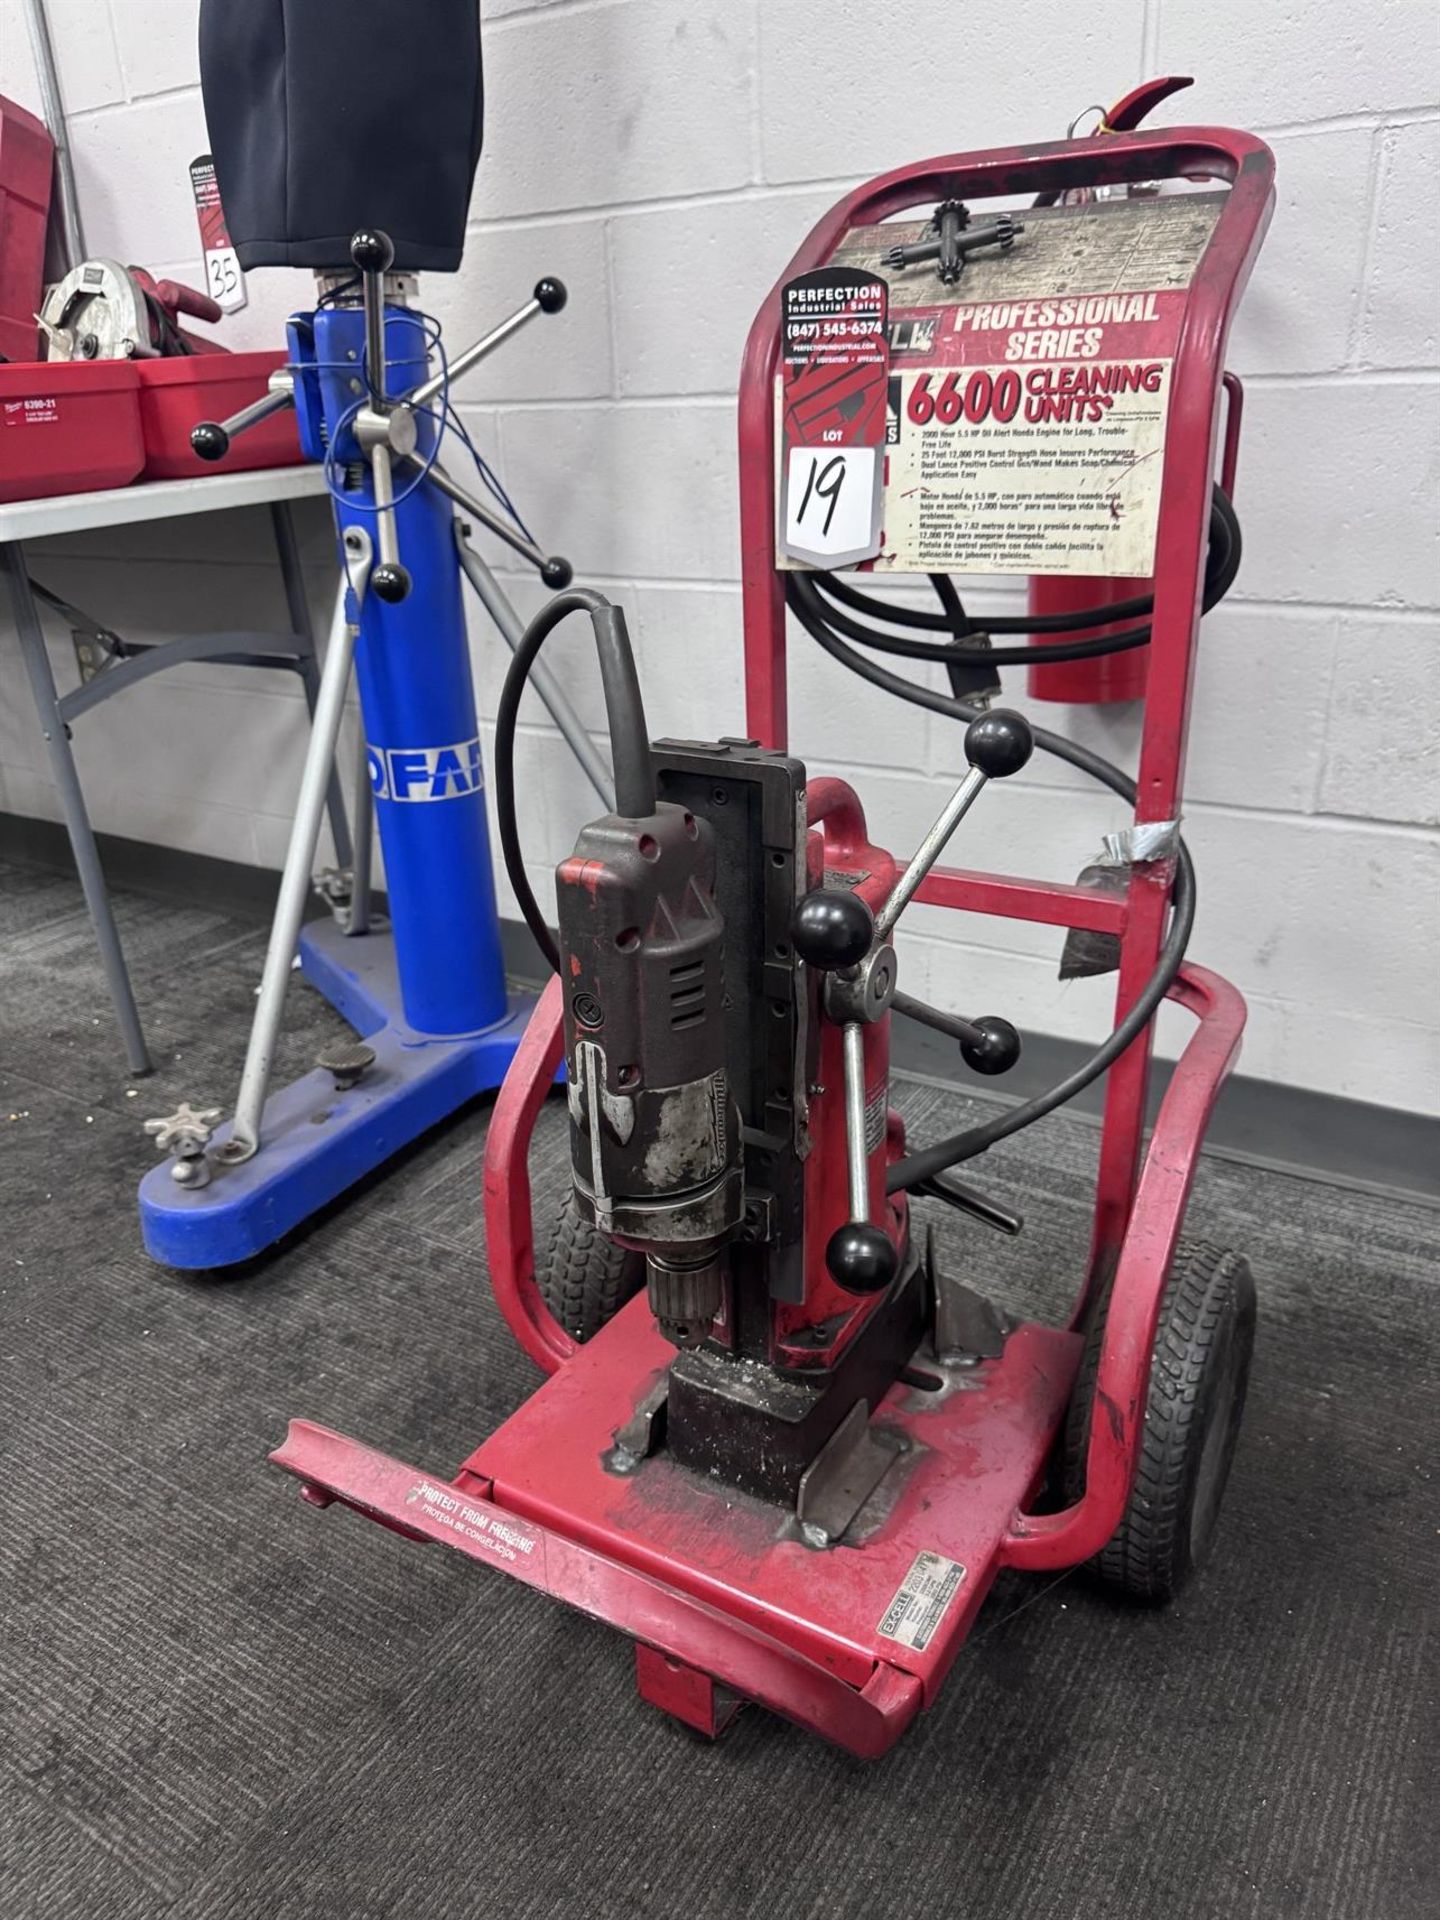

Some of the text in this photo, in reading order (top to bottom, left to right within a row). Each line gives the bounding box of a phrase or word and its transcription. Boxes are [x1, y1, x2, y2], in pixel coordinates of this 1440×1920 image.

[212, 257, 237, 298] 35
[788, 285, 881, 303] PERFECTION
[788, 301, 882, 313] Industrial Sales
[953, 294, 1160, 332] PROFESSIONAL
[787, 321, 883, 340] (847) 545-6374
[1004, 327, 1103, 361] SERIES
[1025, 363, 1164, 395] CLEANING
[907, 369, 1022, 426] 6600
[823, 430, 843, 442] LOT
[993, 429, 1011, 437] Alert
[1036, 429, 1060, 437] Engine
[1098, 427, 1128, 435] Trouble-
[949, 450, 972, 459] 12,000
[974, 450, 985, 458] PSI
[987, 449, 1006, 458] Burst
[1008, 449, 1037, 459] Strength
[1088, 448, 1135, 457] Performance
[960, 460, 987, 468] Positive
[989, 460, 1015, 468] Control
[1055, 459, 1079, 467] Makes
[921, 471, 977, 480] Application Easy
[797, 455, 846, 537] 19
[1034, 492, 1074, 500] automático
[978, 503, 997, 511] 2,000
[1058, 503, 1077, 511] larga
[1017, 523, 1036, 531] largo
[1083, 524, 1110, 532] ruptura
[920, 532, 942, 540] 12,000
[974, 533, 1004, 541] asegurar
[919, 541, 942, 549] Pistola
[979, 542, 1006, 550] positivo
[1068, 543, 1095, 551] facilita
[965, 551, 991, 559] jabones
[420, 1484, 461, 1513] PROTECT
[460, 1507, 489, 1529] FROM
[454, 1521, 466, 1533] DE
[883, 1594, 911, 1633] EX-CELL
